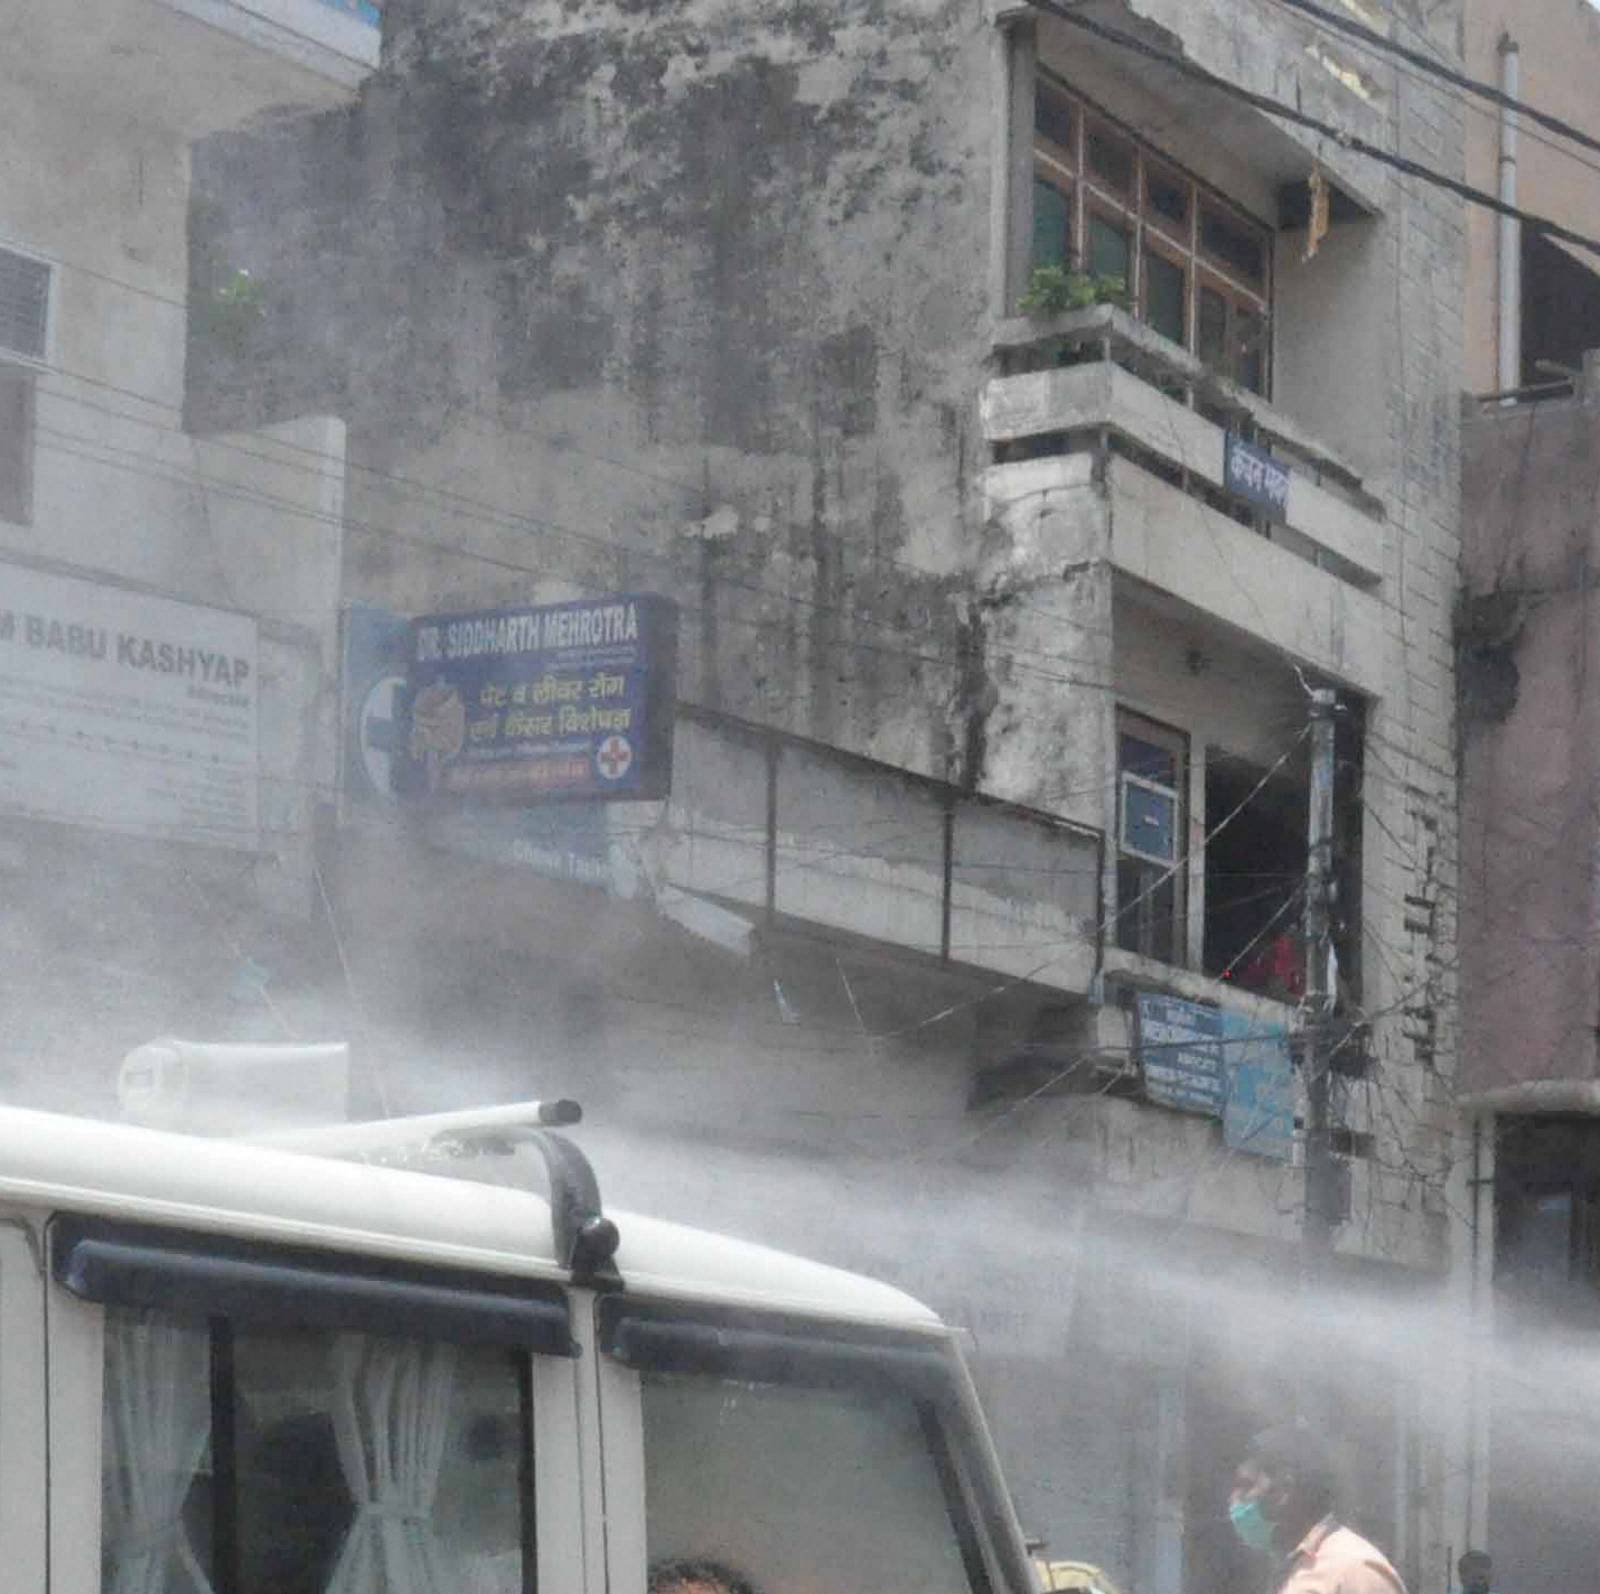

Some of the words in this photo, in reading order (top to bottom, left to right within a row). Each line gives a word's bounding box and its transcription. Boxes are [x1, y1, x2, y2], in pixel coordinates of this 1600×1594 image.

[24, 613, 109, 661] BABU
[116, 630, 251, 687] KASHYAP
[446, 612, 540, 660] SIDDHARTH
[541, 602, 639, 650] MEHROTRA
